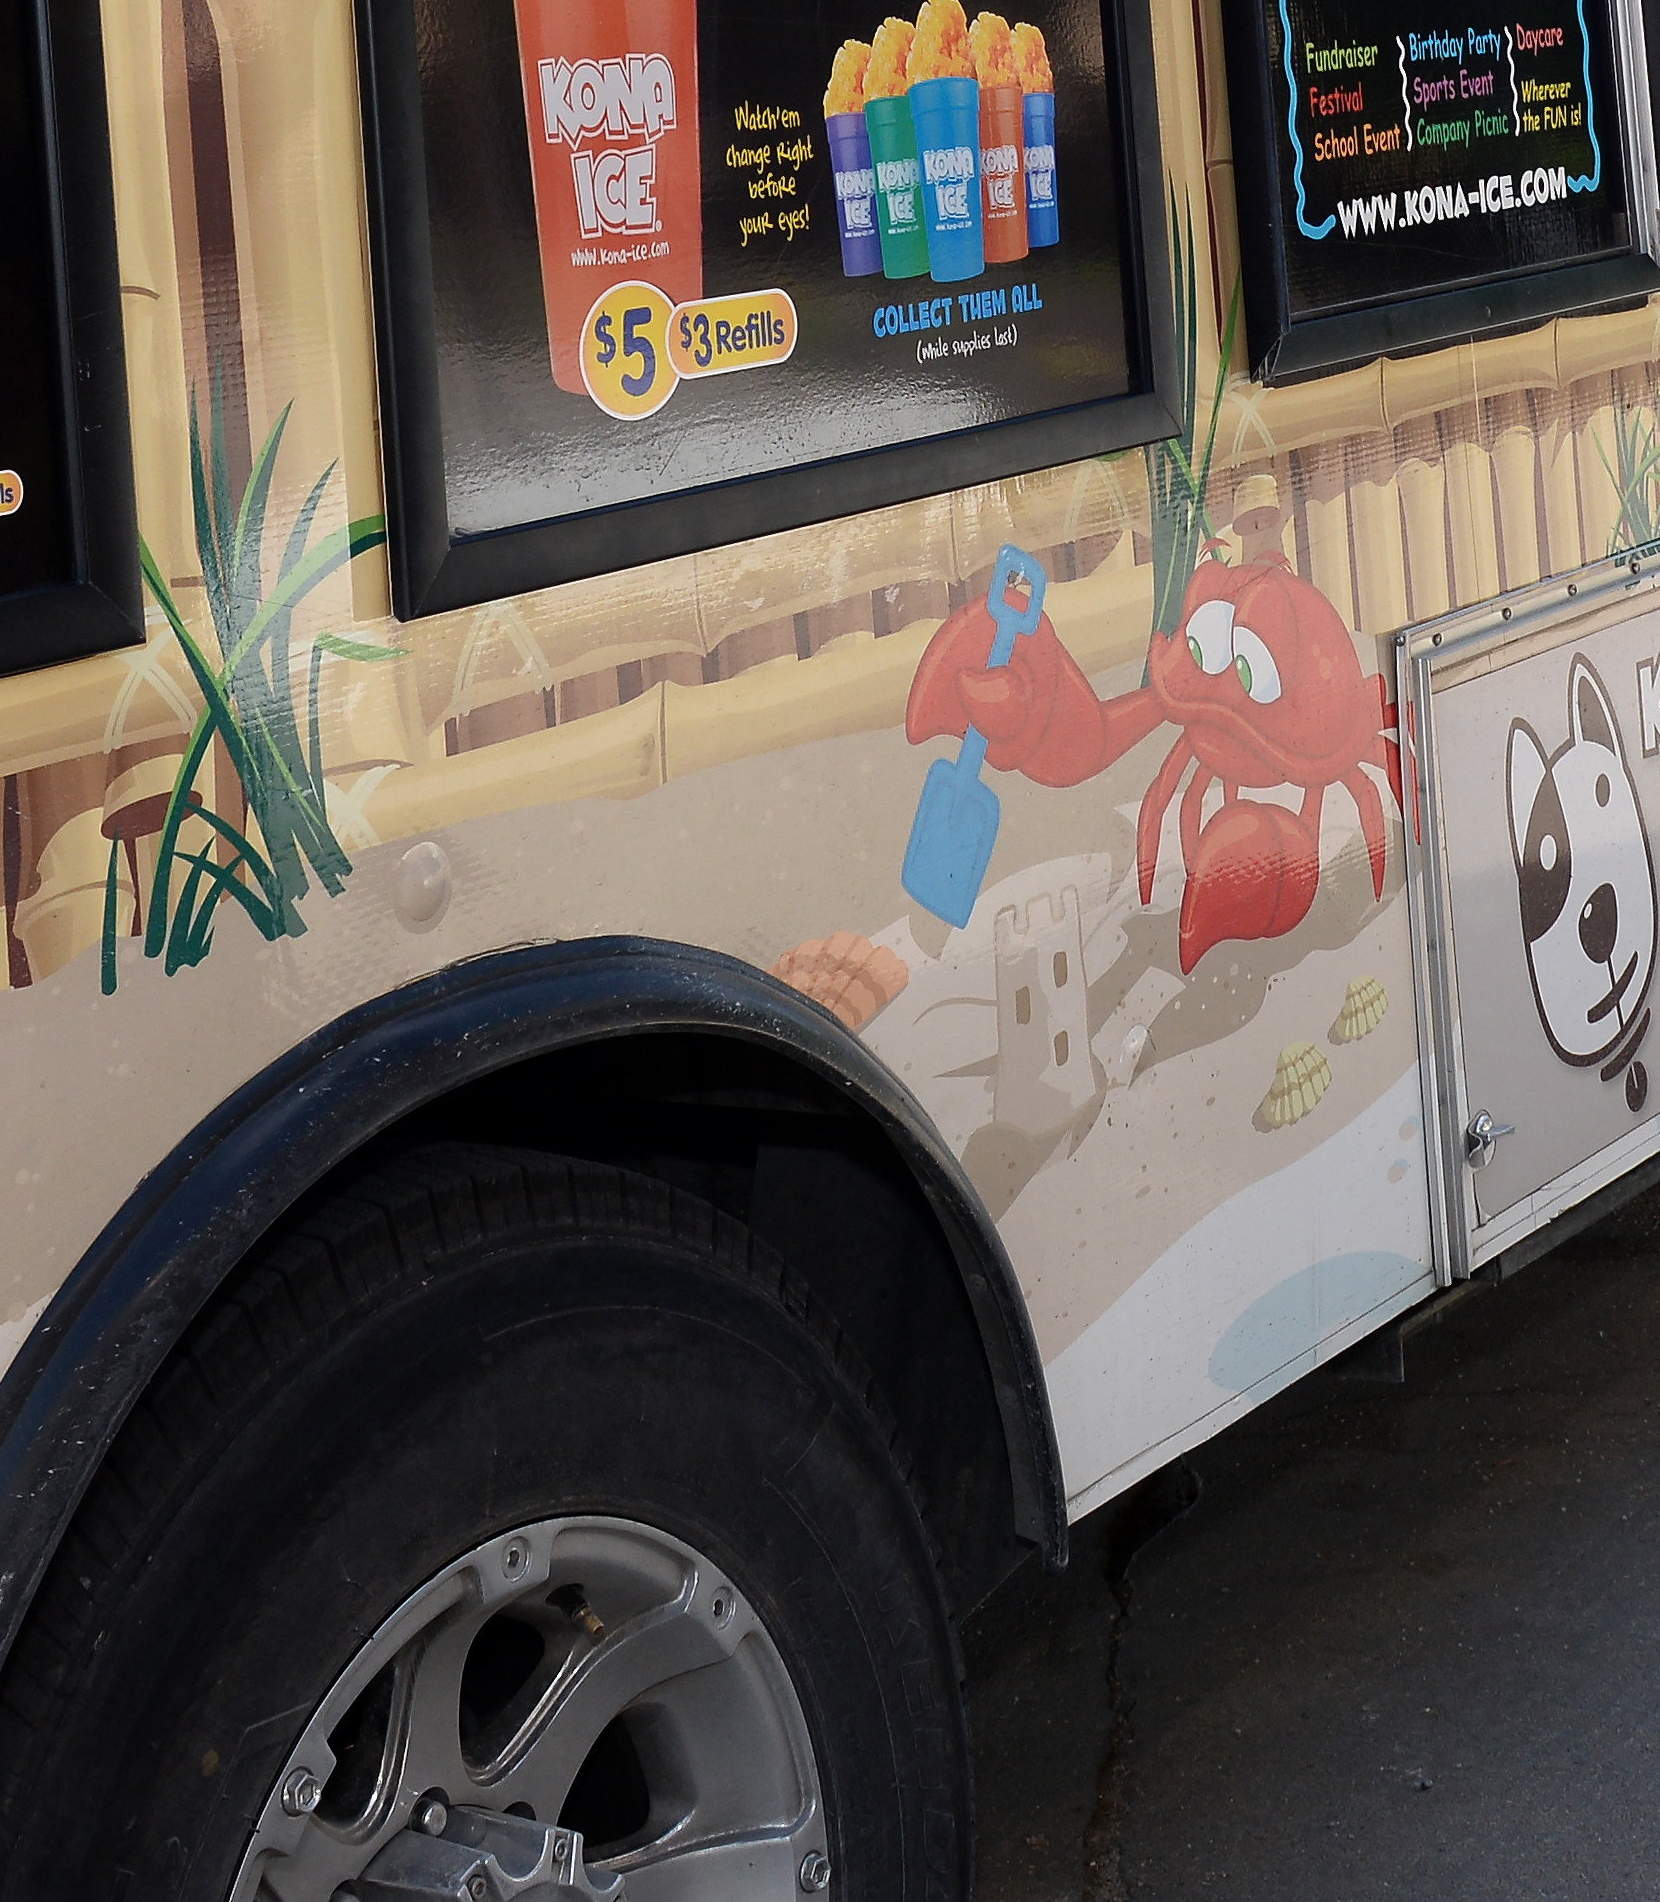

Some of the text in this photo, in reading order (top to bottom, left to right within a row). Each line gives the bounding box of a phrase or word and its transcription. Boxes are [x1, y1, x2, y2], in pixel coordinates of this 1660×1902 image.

[1306, 40, 1378, 73] Fundraiser
[1409, 27, 1501, 65] Birthday Party
[1516, 23, 1563, 56] Daycare
[537, 53, 676, 143] KONA
[1309, 81, 1363, 117] Festival
[1414, 69, 1494, 111] Sports Event
[1521, 80, 1571, 103] Wherever
[1417, 108, 1509, 151] Company Picnic
[1523, 102, 1582, 132] the FUN is!
[1315, 123, 1401, 162] School Event
[571, 146, 661, 239] ICE
[1337, 167, 1567, 239] WWW.KONA-ICE.COM
[778, 203, 811, 241] eyes!
[873, 283, 1043, 339] COLLECT THEM ALL
[594, 307, 657, 398] $5
[679, 307, 786, 368] $3 Refills
